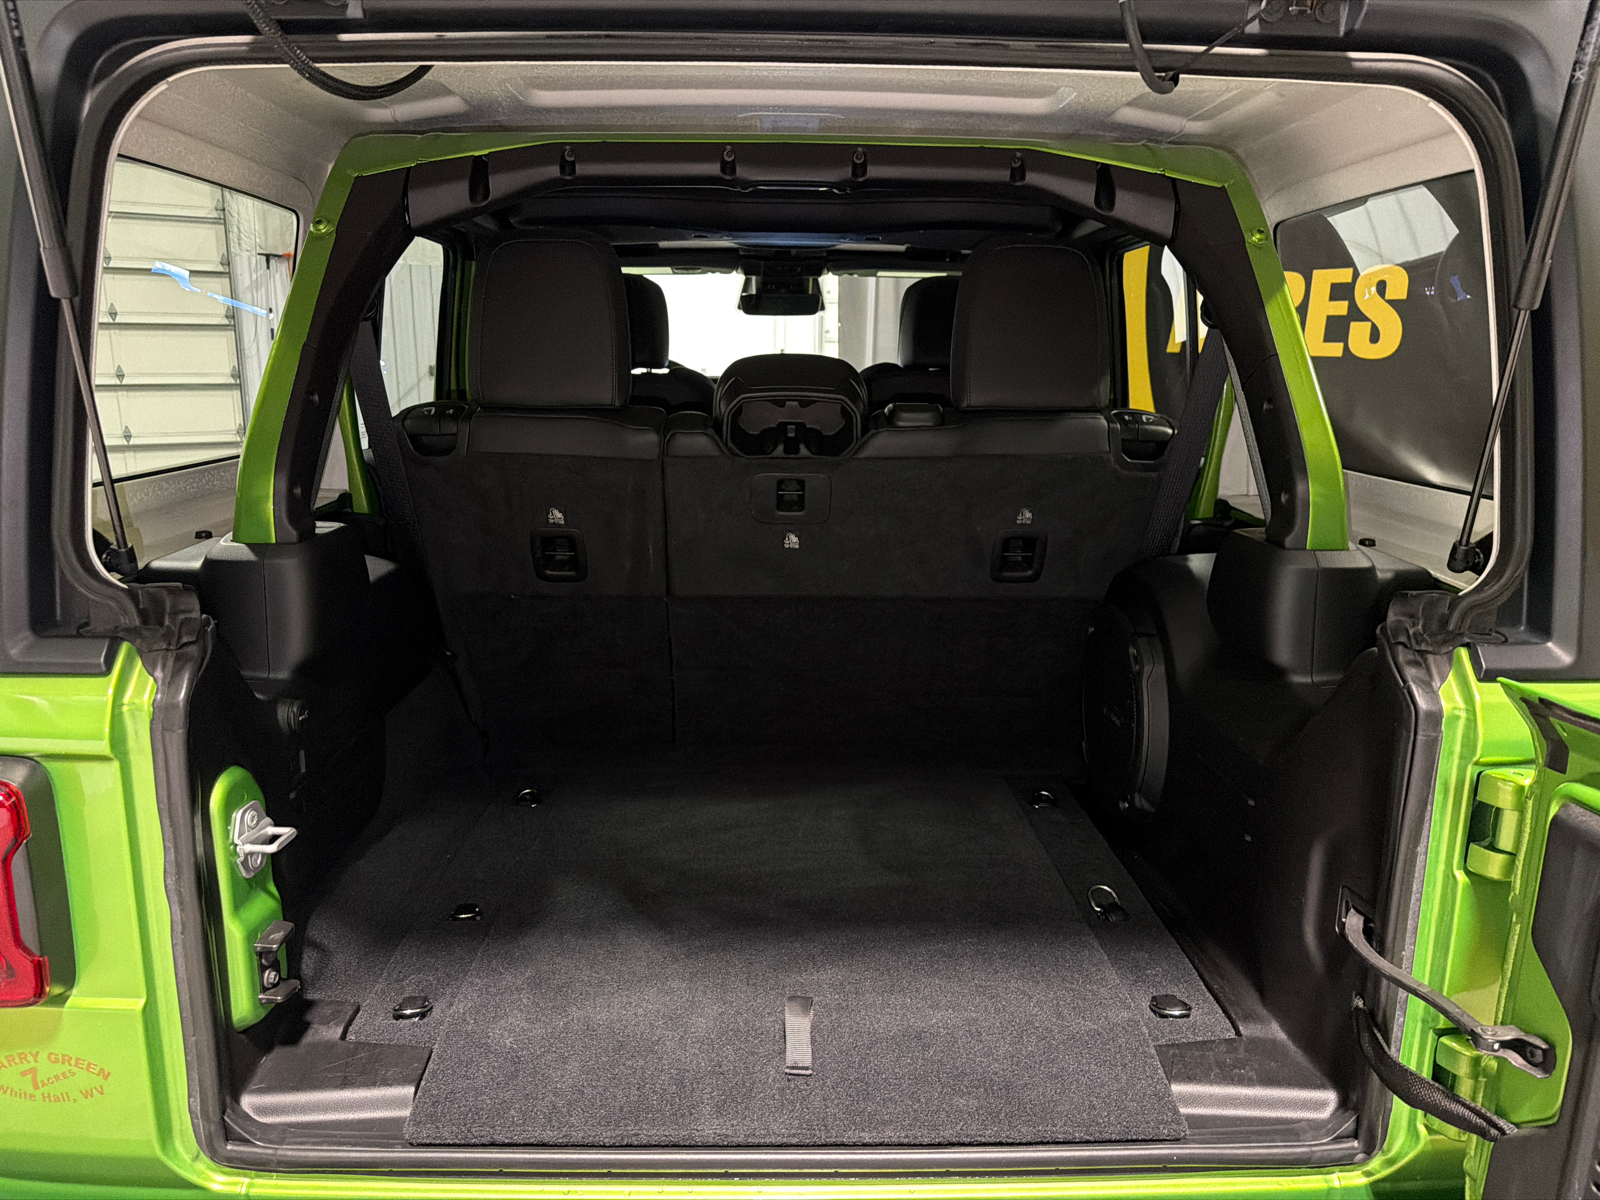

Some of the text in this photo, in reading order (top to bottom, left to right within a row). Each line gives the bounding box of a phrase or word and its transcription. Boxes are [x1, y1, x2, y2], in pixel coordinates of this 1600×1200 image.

[47, 1052, 111, 1081] GREEN
[20, 1067, 40, 1090] 7
[40, 1069, 76, 1088] ACRES
[42, 1091, 77, 1103] Hall,
[79, 1085, 104, 1099] WV
